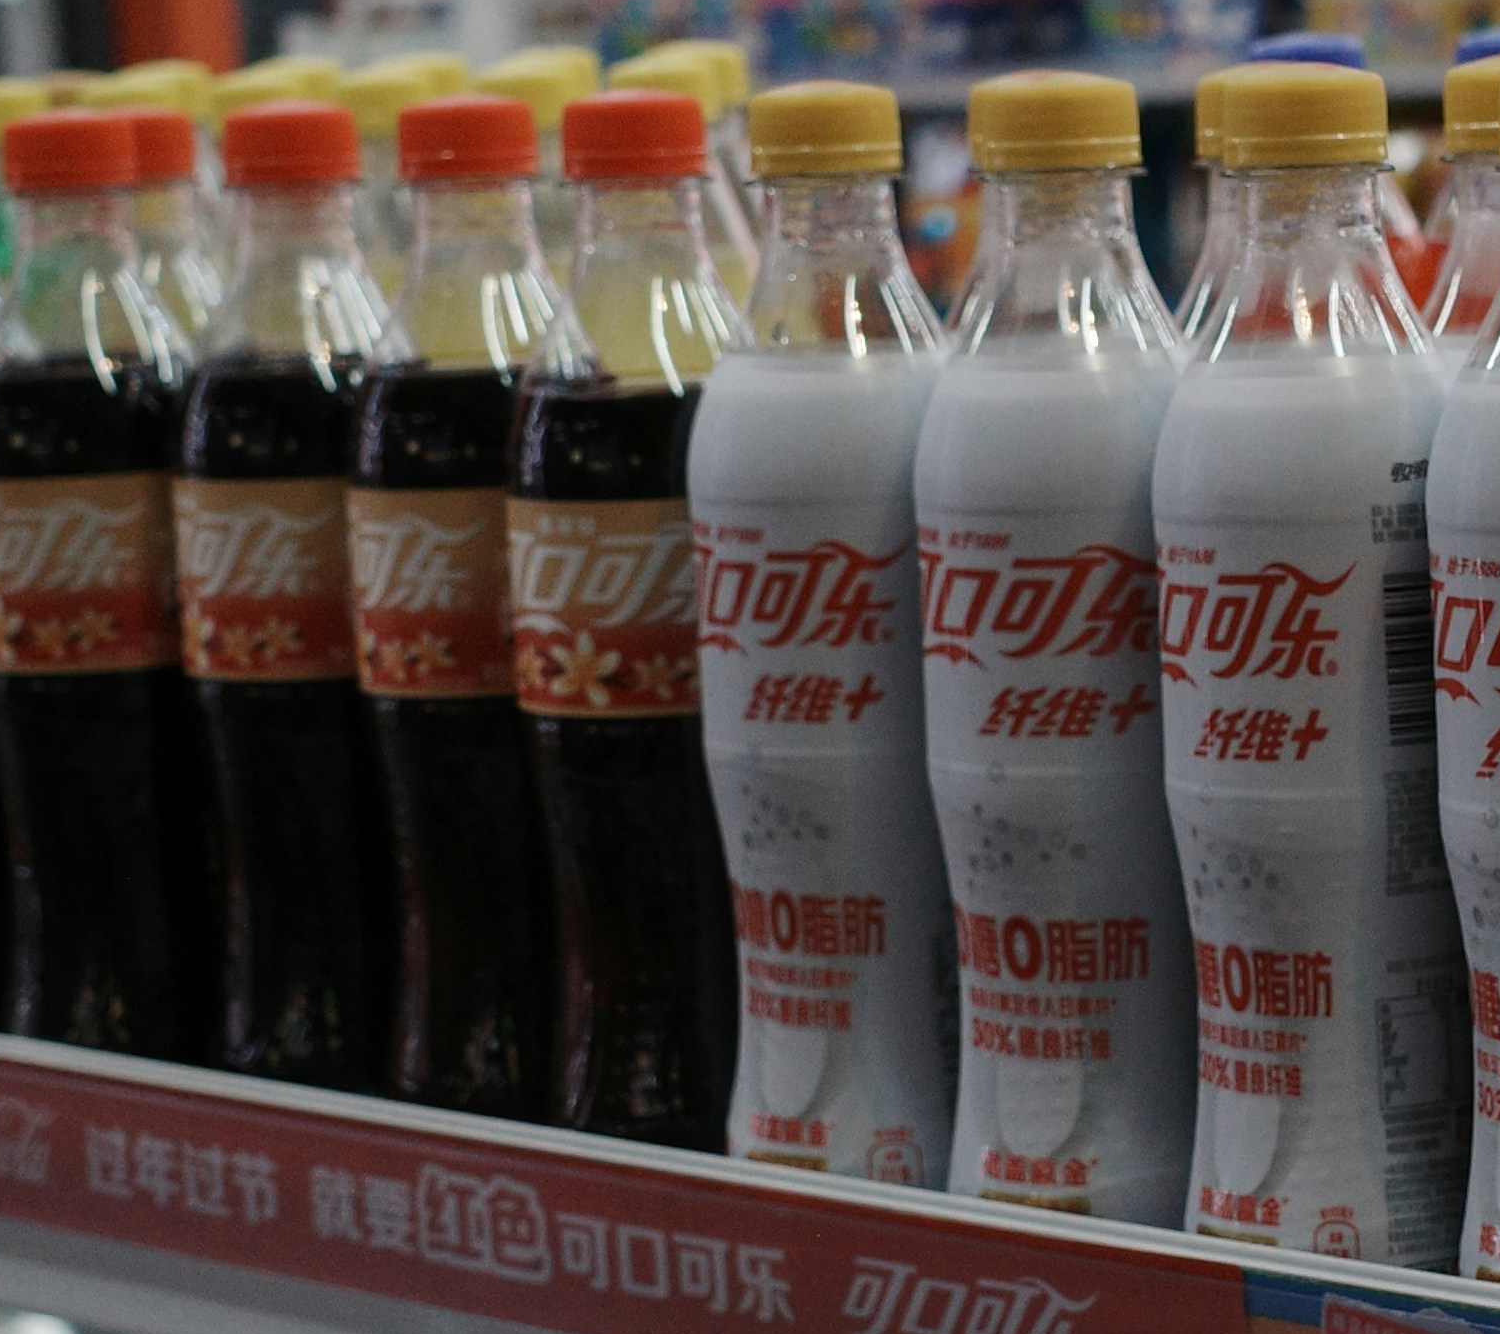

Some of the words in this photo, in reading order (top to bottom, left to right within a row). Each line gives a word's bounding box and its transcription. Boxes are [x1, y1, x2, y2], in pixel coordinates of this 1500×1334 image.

[694, 539, 912, 655] 口可乐
[1194, 709, 1328, 762] 纤维+
[84, 1123, 281, 1225] 过年过节
[310, 1161, 798, 1325] 就要红色可口可乐
